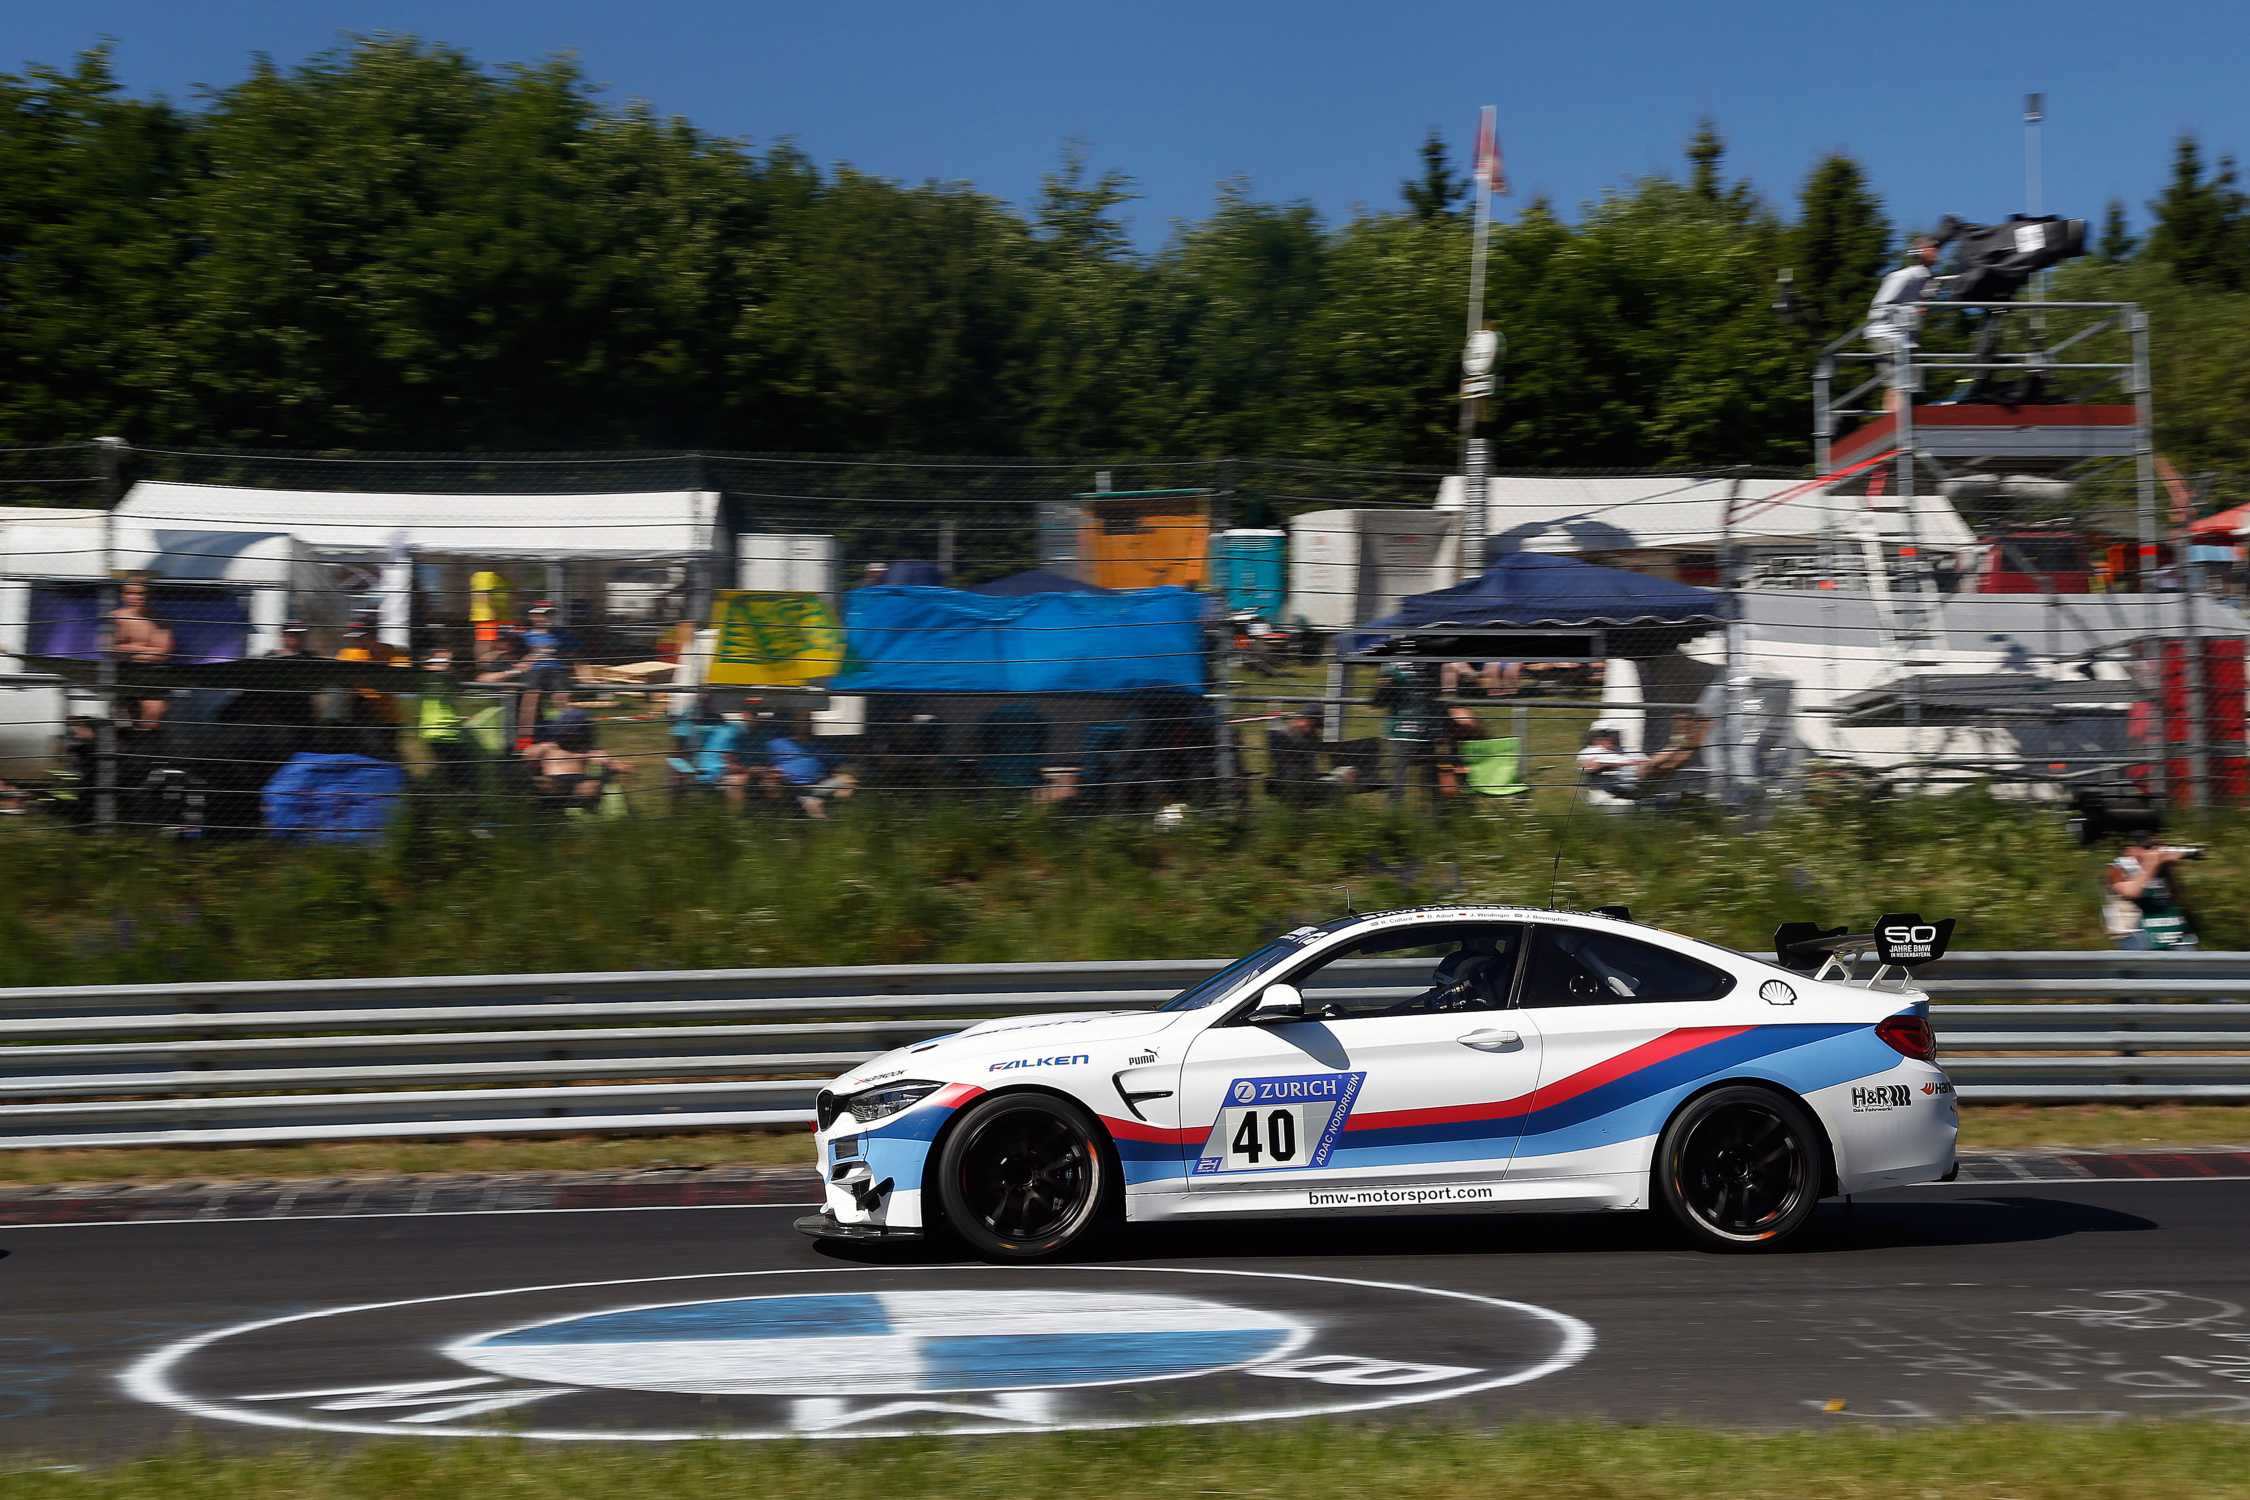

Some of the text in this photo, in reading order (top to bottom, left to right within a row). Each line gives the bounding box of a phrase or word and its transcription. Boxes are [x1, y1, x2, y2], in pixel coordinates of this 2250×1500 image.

[1889, 944, 1931, 953] JAHRE BMW
[988, 1054, 1089, 1072] FALKEN
[1129, 1054, 1156, 1066] PUMA
[1260, 1080, 1337, 1099] ZURICH
[1851, 1085, 1890, 1107] H&R
[1315, 1073, 1360, 1166] ADAC NORDRHEIN
[1232, 1109, 1296, 1163] 40
[1308, 1186, 1493, 1205] bmw-motorsport.com
